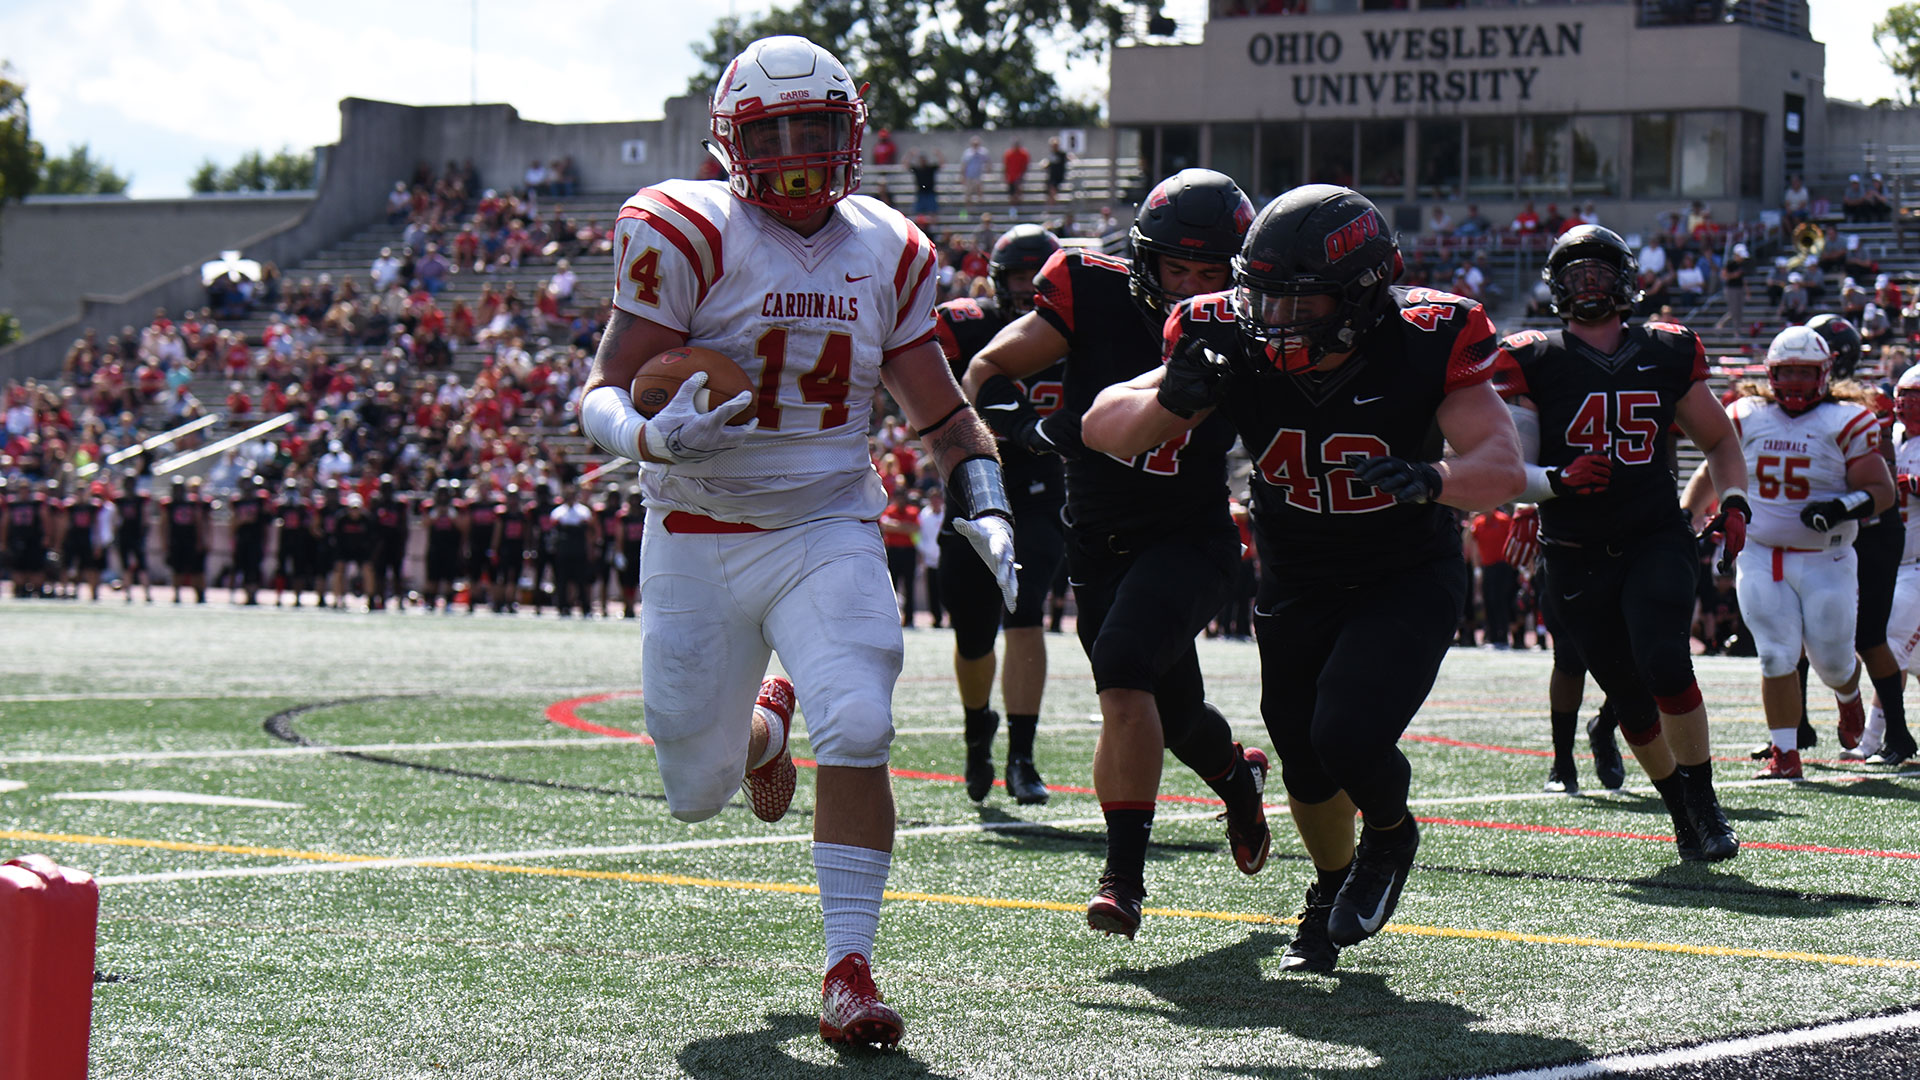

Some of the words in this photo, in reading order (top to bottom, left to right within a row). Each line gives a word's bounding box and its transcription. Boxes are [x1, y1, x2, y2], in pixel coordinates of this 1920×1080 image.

[1249, 31, 1343, 66] OHIO
[1363, 22, 1584, 61] WESLEYAN
[779, 90, 810, 101] CARDS
[1291, 67, 1541, 106] UNIVERSITY
[1325, 208, 1380, 264] OWU
[761, 292, 859, 321] CARDINALS
[754, 325, 853, 432] 14
[1565, 390, 1662, 466] 45
[1763, 439, 1808, 454] CARDINALS
[1256, 427, 1398, 514] 42
[1755, 455, 1812, 500] 55
